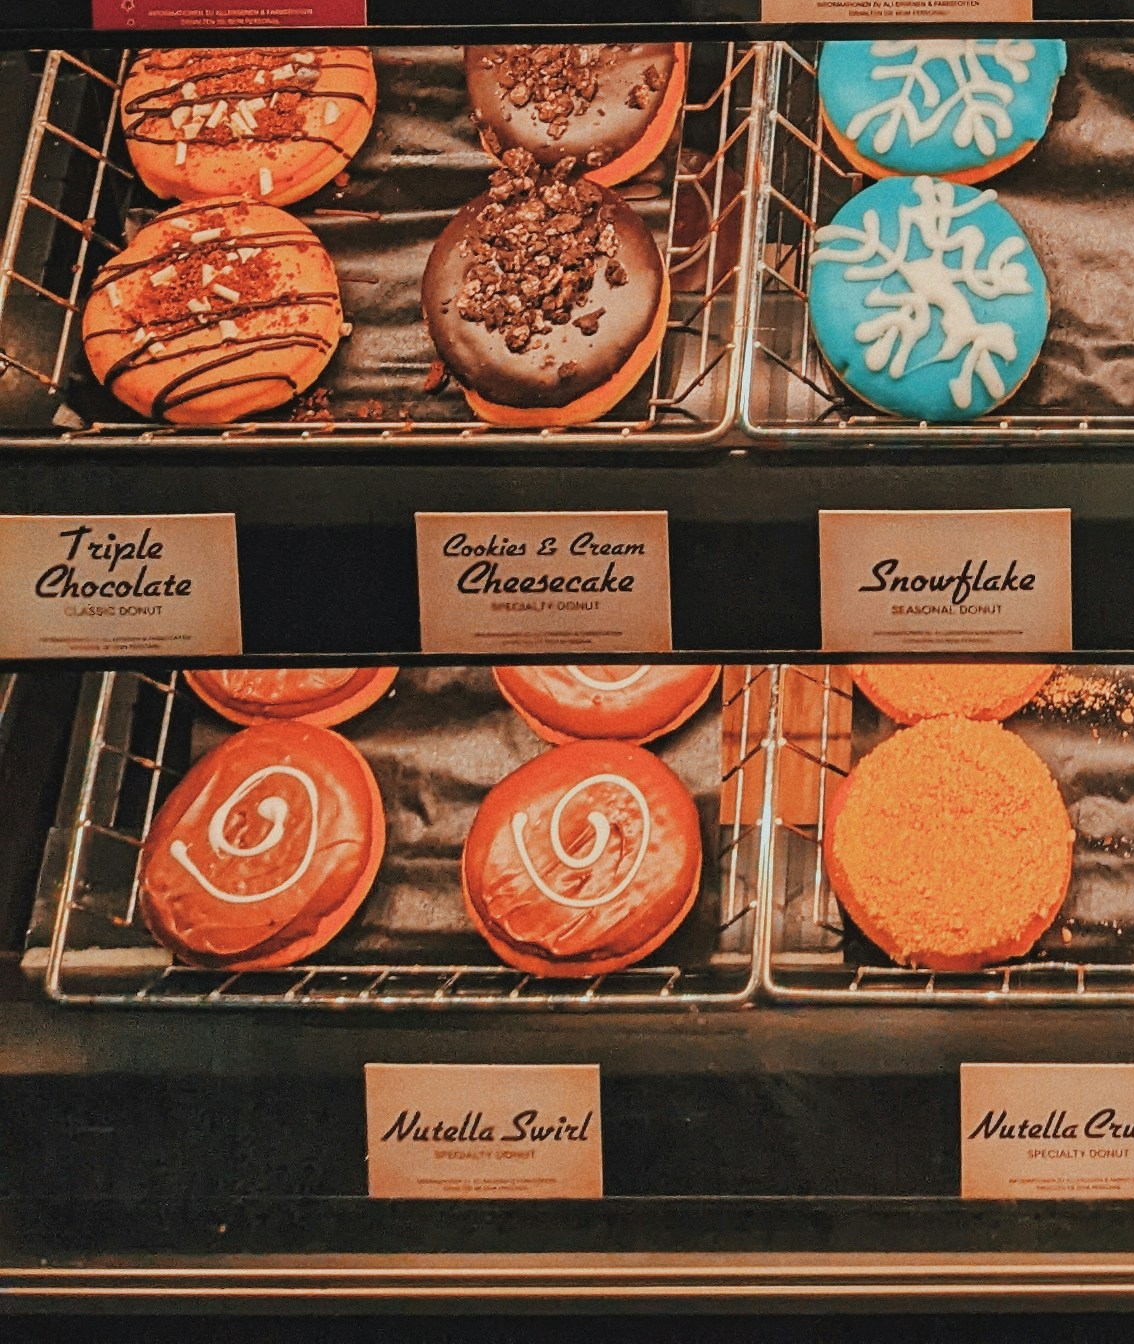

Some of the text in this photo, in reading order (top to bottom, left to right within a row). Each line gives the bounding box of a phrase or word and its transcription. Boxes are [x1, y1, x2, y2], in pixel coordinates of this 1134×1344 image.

[60, 525, 164, 572] Triple
[443, 531, 645, 557] Cookies & Cream
[35, 563, 192, 598] Chocolate
[457, 560, 635, 594] Cheesecake
[858, 558, 1036, 605] Snowflake
[64, 605, 163, 617] CLASSIC DONUT
[491, 600, 600, 612] SPECIALTY DONUT
[891, 604, 1002, 615] SEASONAL DONUT
[380, 1109, 593, 1142] Nutella Swirl
[967, 1109, 1079, 1140] Nutella
[434, 1149, 536, 1160] SPECIALTY DONUT
[1027, 1149, 1129, 1159] SPECIALTY DONUT
